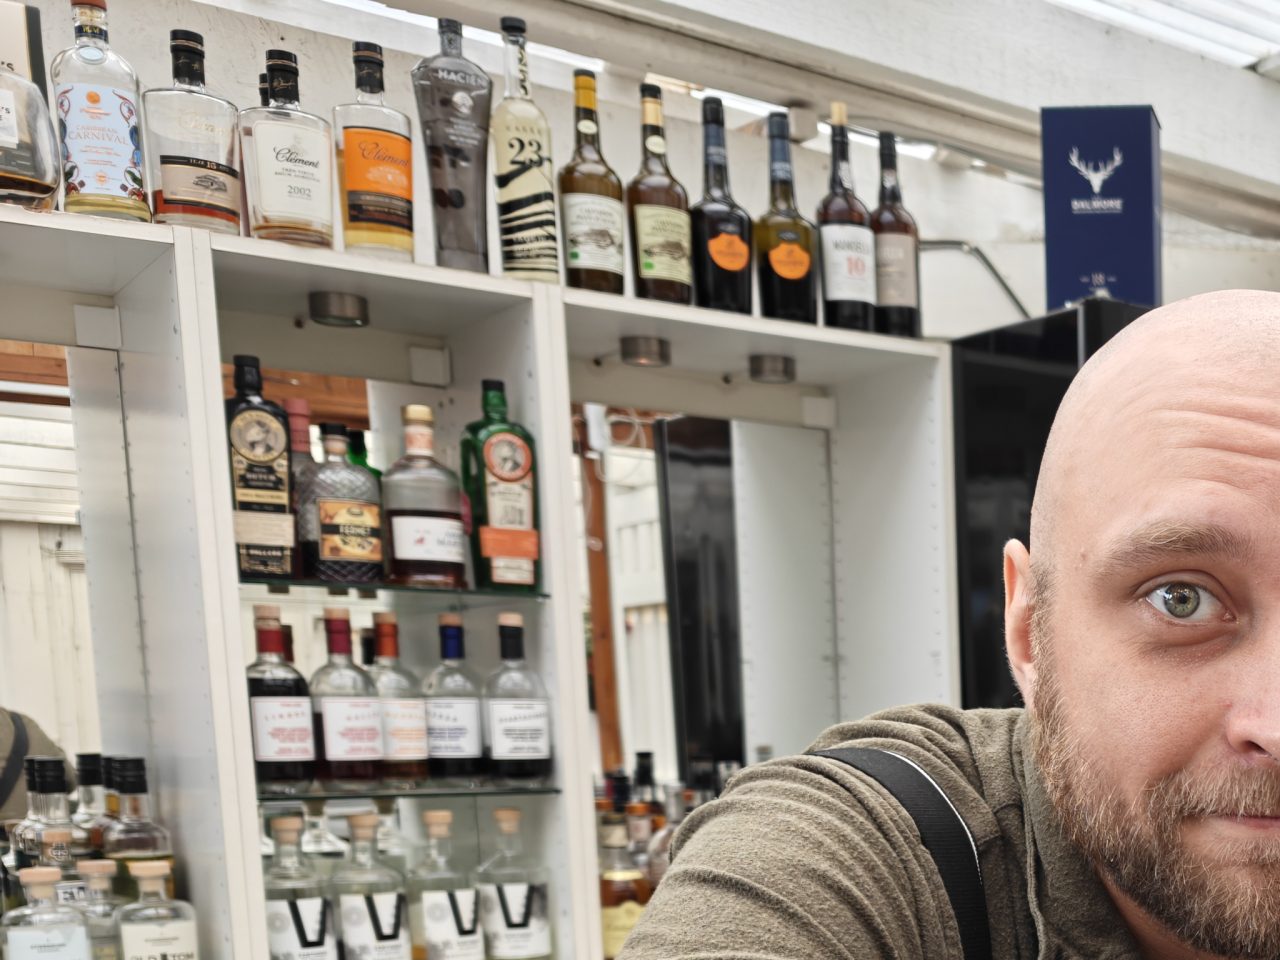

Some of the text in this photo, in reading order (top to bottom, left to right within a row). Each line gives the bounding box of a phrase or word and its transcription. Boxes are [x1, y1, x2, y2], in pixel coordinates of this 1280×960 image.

[68, 131, 129, 146] CARNIVAL
[273, 147, 320, 168] Clément
[509, 137, 545, 167] 23
[287, 184, 312, 198] 2002
